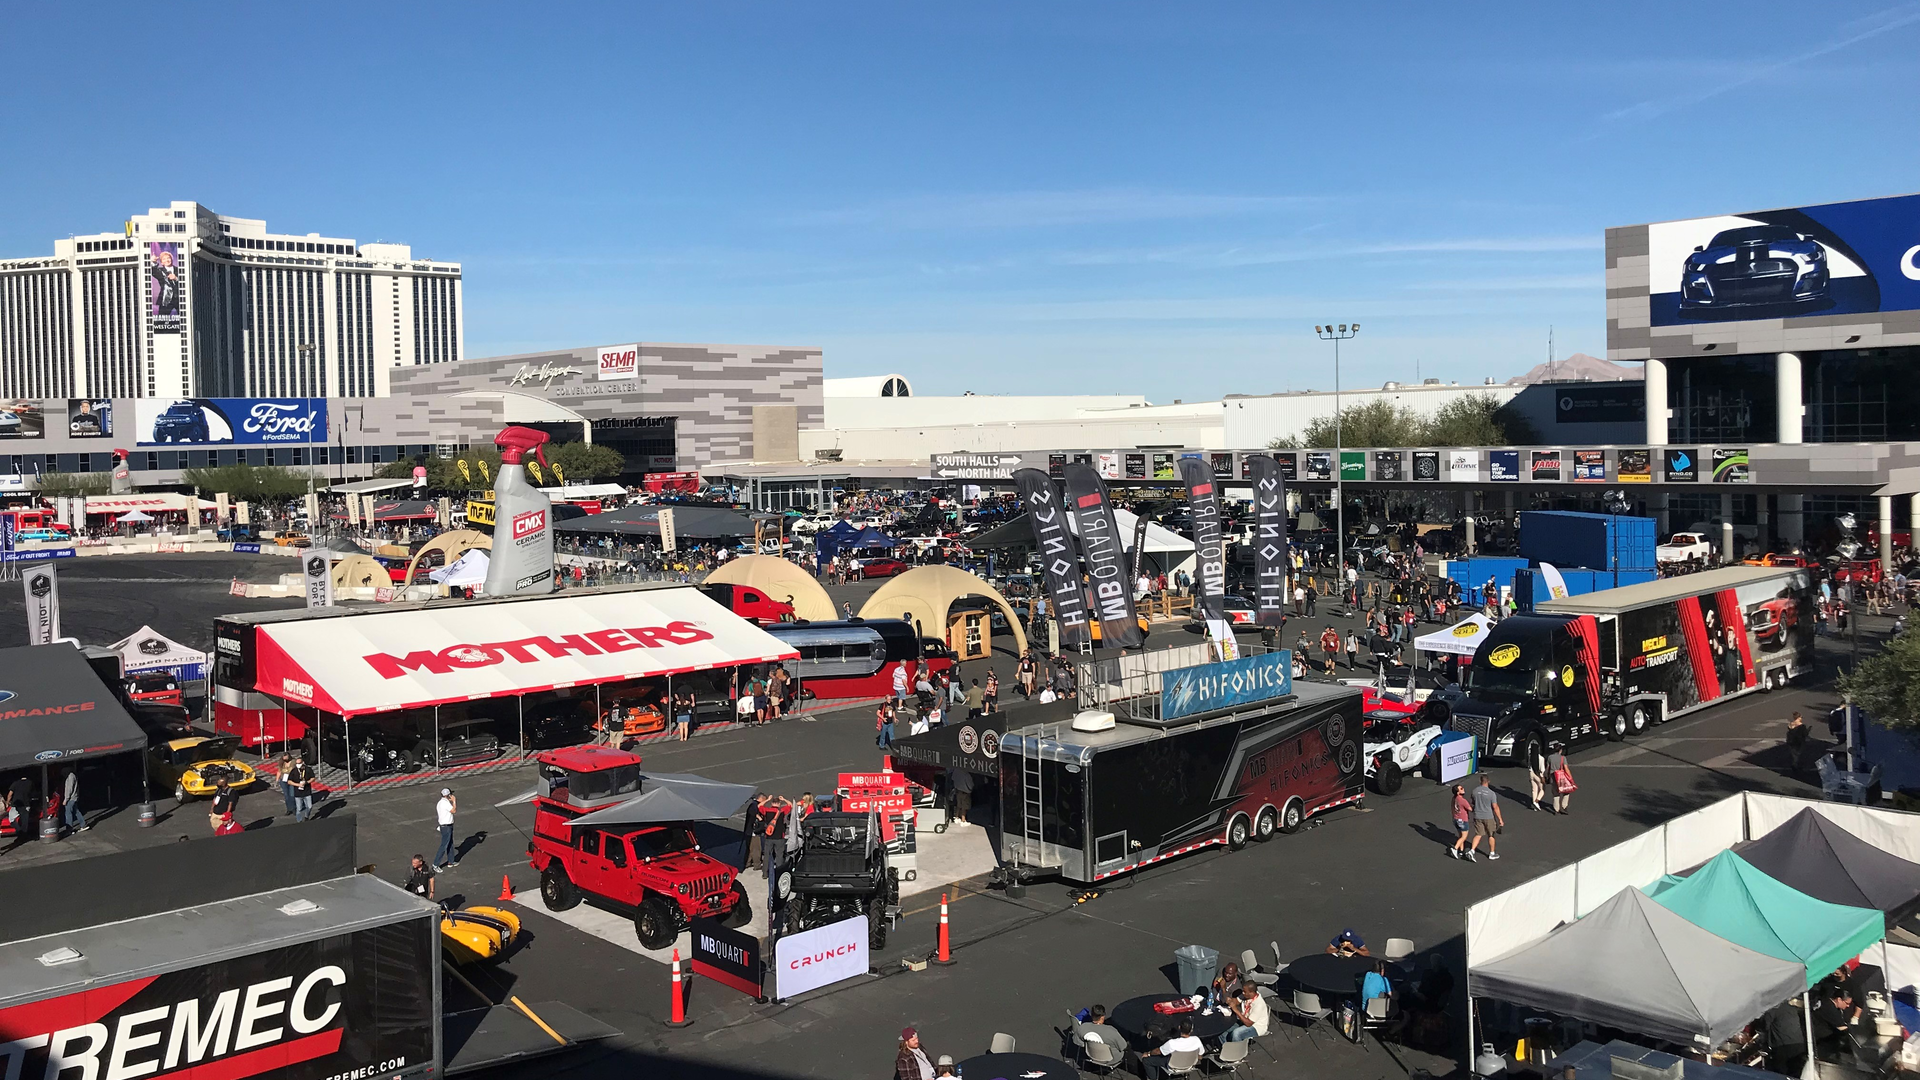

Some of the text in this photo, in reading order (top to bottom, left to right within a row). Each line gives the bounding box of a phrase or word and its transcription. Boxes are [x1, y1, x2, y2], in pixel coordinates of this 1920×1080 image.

[601, 350, 636, 369] SEMA
[556, 383, 637, 397] CONVENTION CENTER
[243, 403, 317, 433] Ford
[937, 456, 998, 466] SOUTH HALLS
[959, 467, 1021, 479] NORTH HALL
[86, 499, 166, 507] OTHERS
[516, 515, 543, 534] CMX
[516, 531, 545, 546] CERAMIC
[319, 581, 325, 589] BY
[517, 578, 533, 590] PRO
[40, 604, 48, 627] JOIN
[218, 637, 241, 651] MOTHERS
[362, 620, 714, 679] MOTHERS
[1643, 635, 1667, 652] MECUM
[1630, 651, 1678, 668] AUTO TRANSPORT
[283, 678, 313, 698] MOTHERS
[1200, 663, 1285, 700] HIFONICS
[900, 745, 939, 763] MBQUART
[852, 775, 889, 785] MBQUART
[1270, 750, 1328, 793] HIFONICS
[850, 799, 904, 809] CRUNCH
[641, 871, 669, 883] RUBICON
[701, 934, 747, 967] MBQUART
[790, 942, 856, 970] CRUNCH
